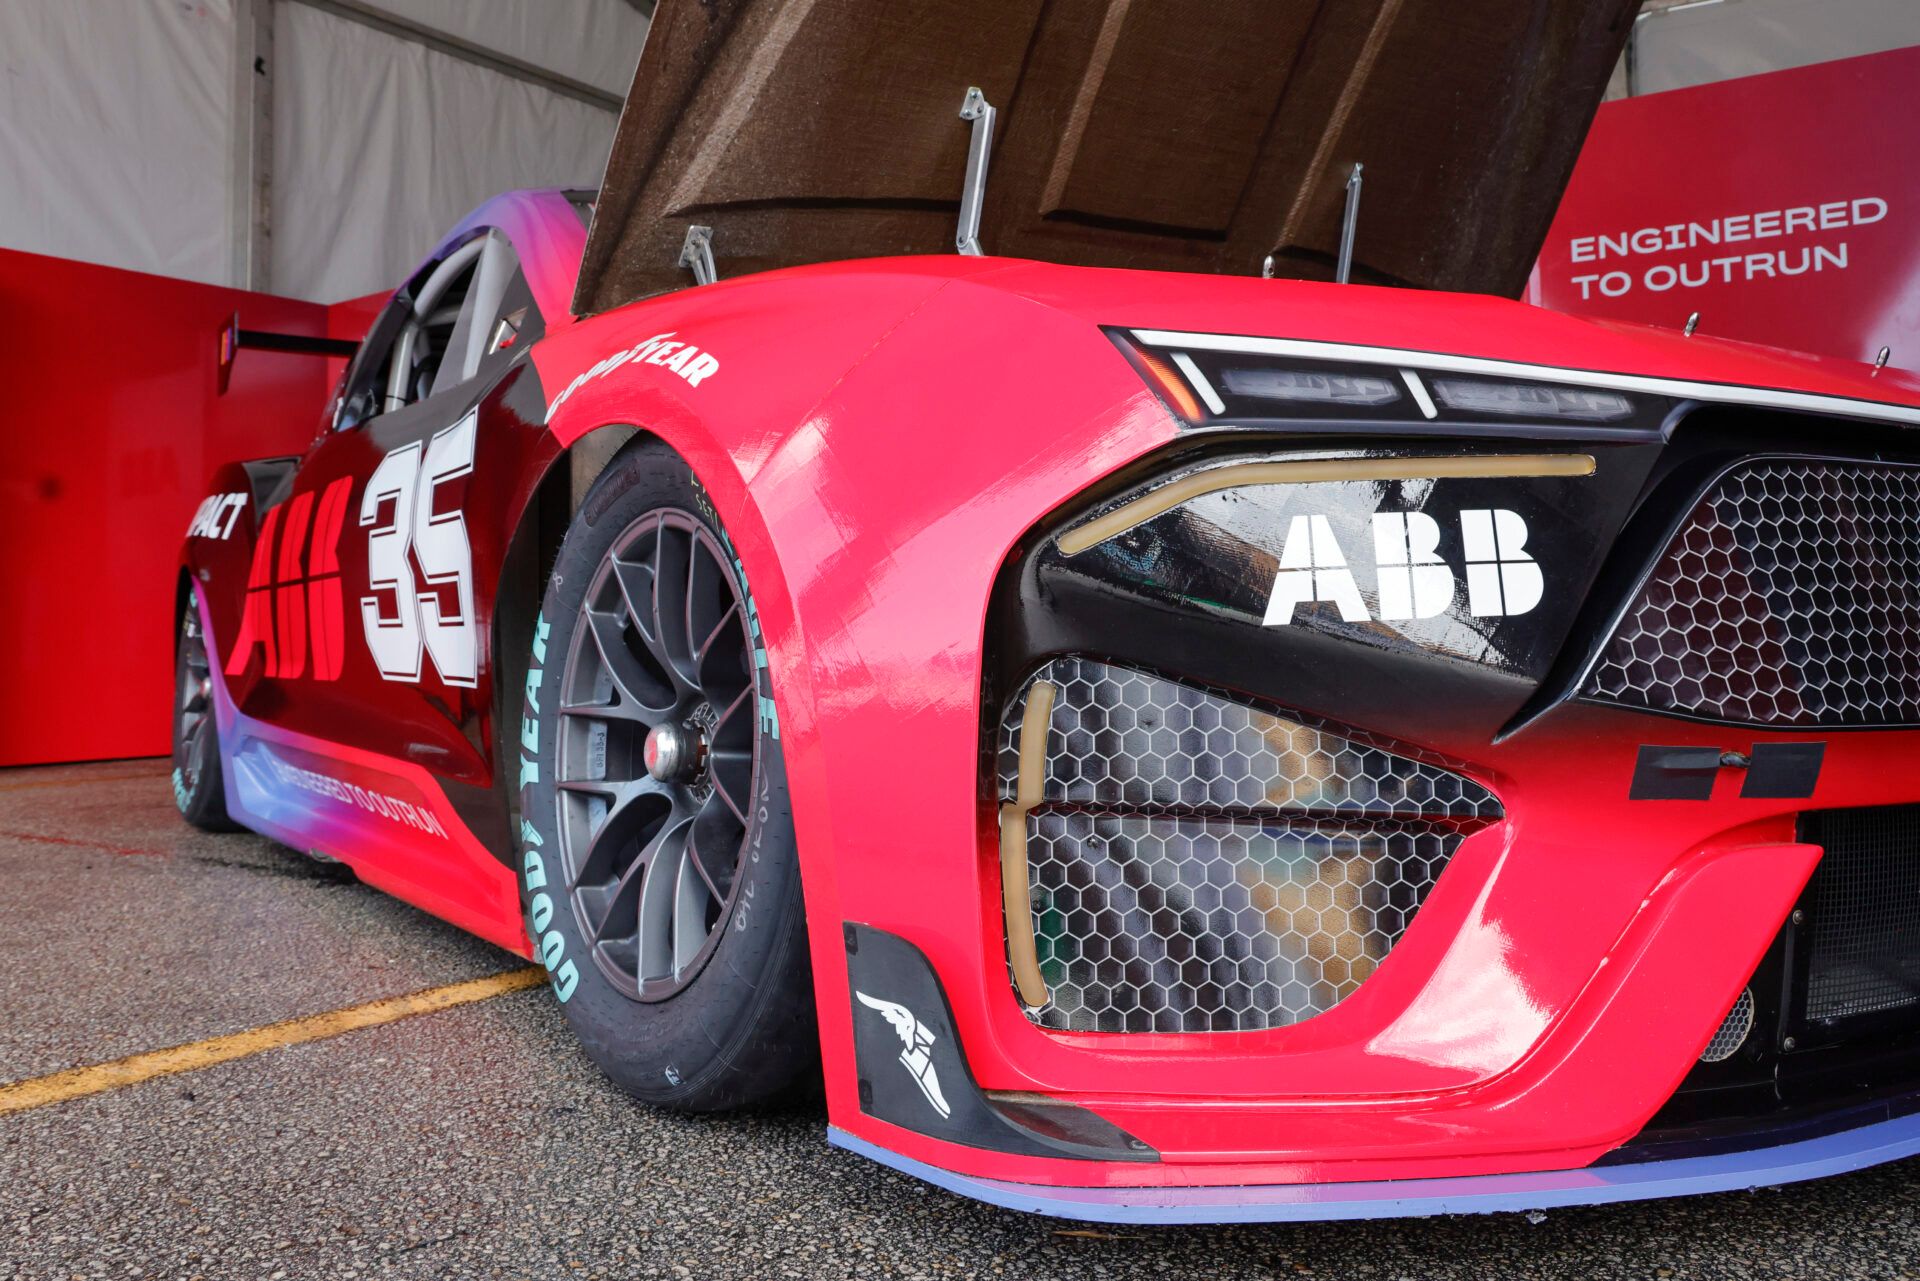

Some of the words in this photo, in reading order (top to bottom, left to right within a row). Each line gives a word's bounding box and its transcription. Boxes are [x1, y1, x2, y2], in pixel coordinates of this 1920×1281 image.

[1570, 197, 1888, 263] ENGINEERED
[1571, 271, 1632, 300] TO
[1643, 242, 1849, 292] OUTRUN
[225, 475, 353, 681] ABB
[359, 405, 478, 689] 35
[1262, 508, 1545, 627] ABB
